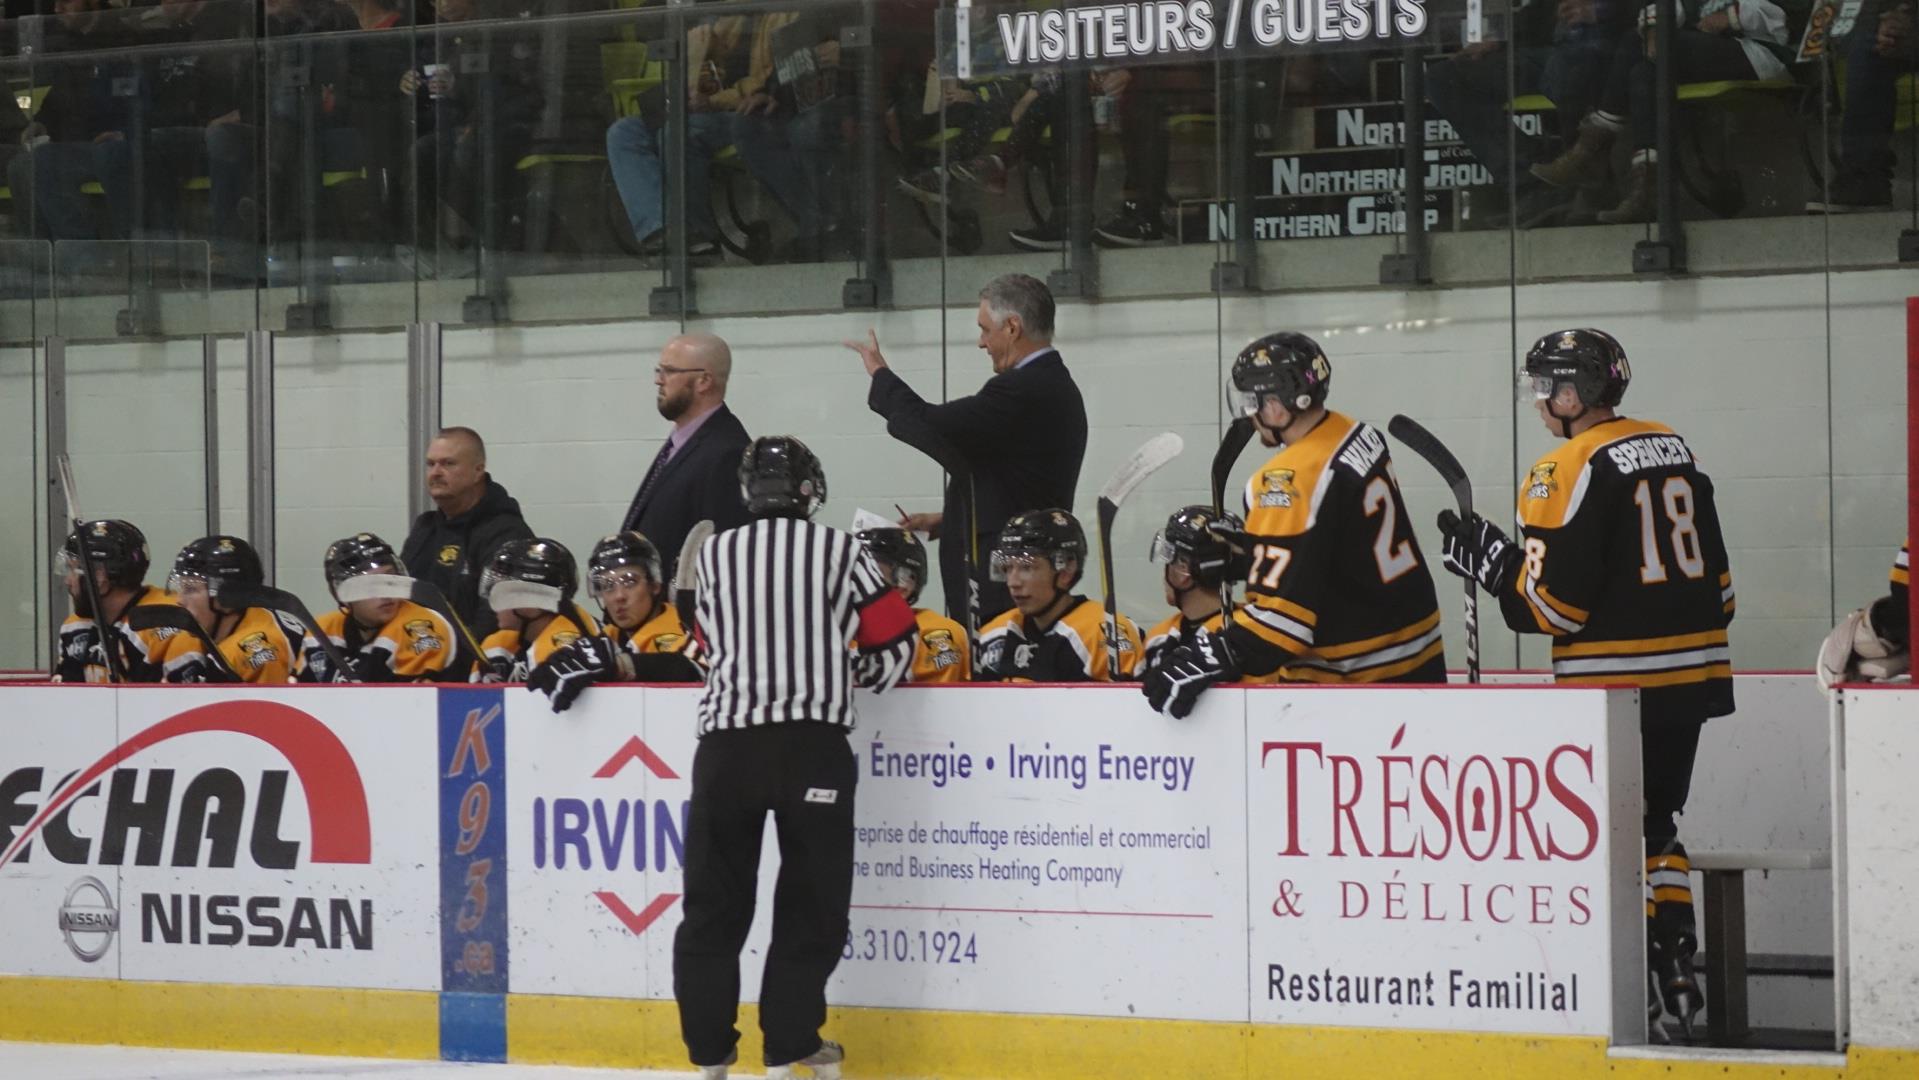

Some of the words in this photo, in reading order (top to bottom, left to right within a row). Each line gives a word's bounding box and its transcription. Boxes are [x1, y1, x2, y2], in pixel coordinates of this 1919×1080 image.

[998, 1, 1216, 64] VISITEURS
[1250, 0, 1428, 45] GUESTS
[1208, 202, 1341, 241] NRTHERN
[1347, 196, 1439, 235] GROP
[1608, 437, 1692, 475] SPENCER
[1633, 476, 1704, 585] 18
[870, 730, 973, 788] Énergie
[1009, 742, 1087, 790] Irving
[1098, 744, 1195, 791] Energy
[1261, 722, 1600, 862] TRÉSORS
[533, 796, 691, 872] IRVIN
[908, 820, 928, 844] de
[932, 821, 1009, 851] chauffage
[1013, 822, 1094, 849] résidentiel
[1099, 828, 1114, 848] et
[1119, 825, 1211, 850] commercial
[874, 855, 904, 878] and
[909, 855, 974, 880] Business
[979, 857, 1041, 887] Heating
[1046, 858, 1124, 889] Company
[1272, 879, 1305, 918] &
[1339, 869, 1593, 926] DÉLICES
[65, 913, 113, 928] NISSAN
[141, 893, 373, 951] NISSAN
[1268, 963, 1435, 1007] Restaurant
[1449, 969, 1579, 1012] Familial
